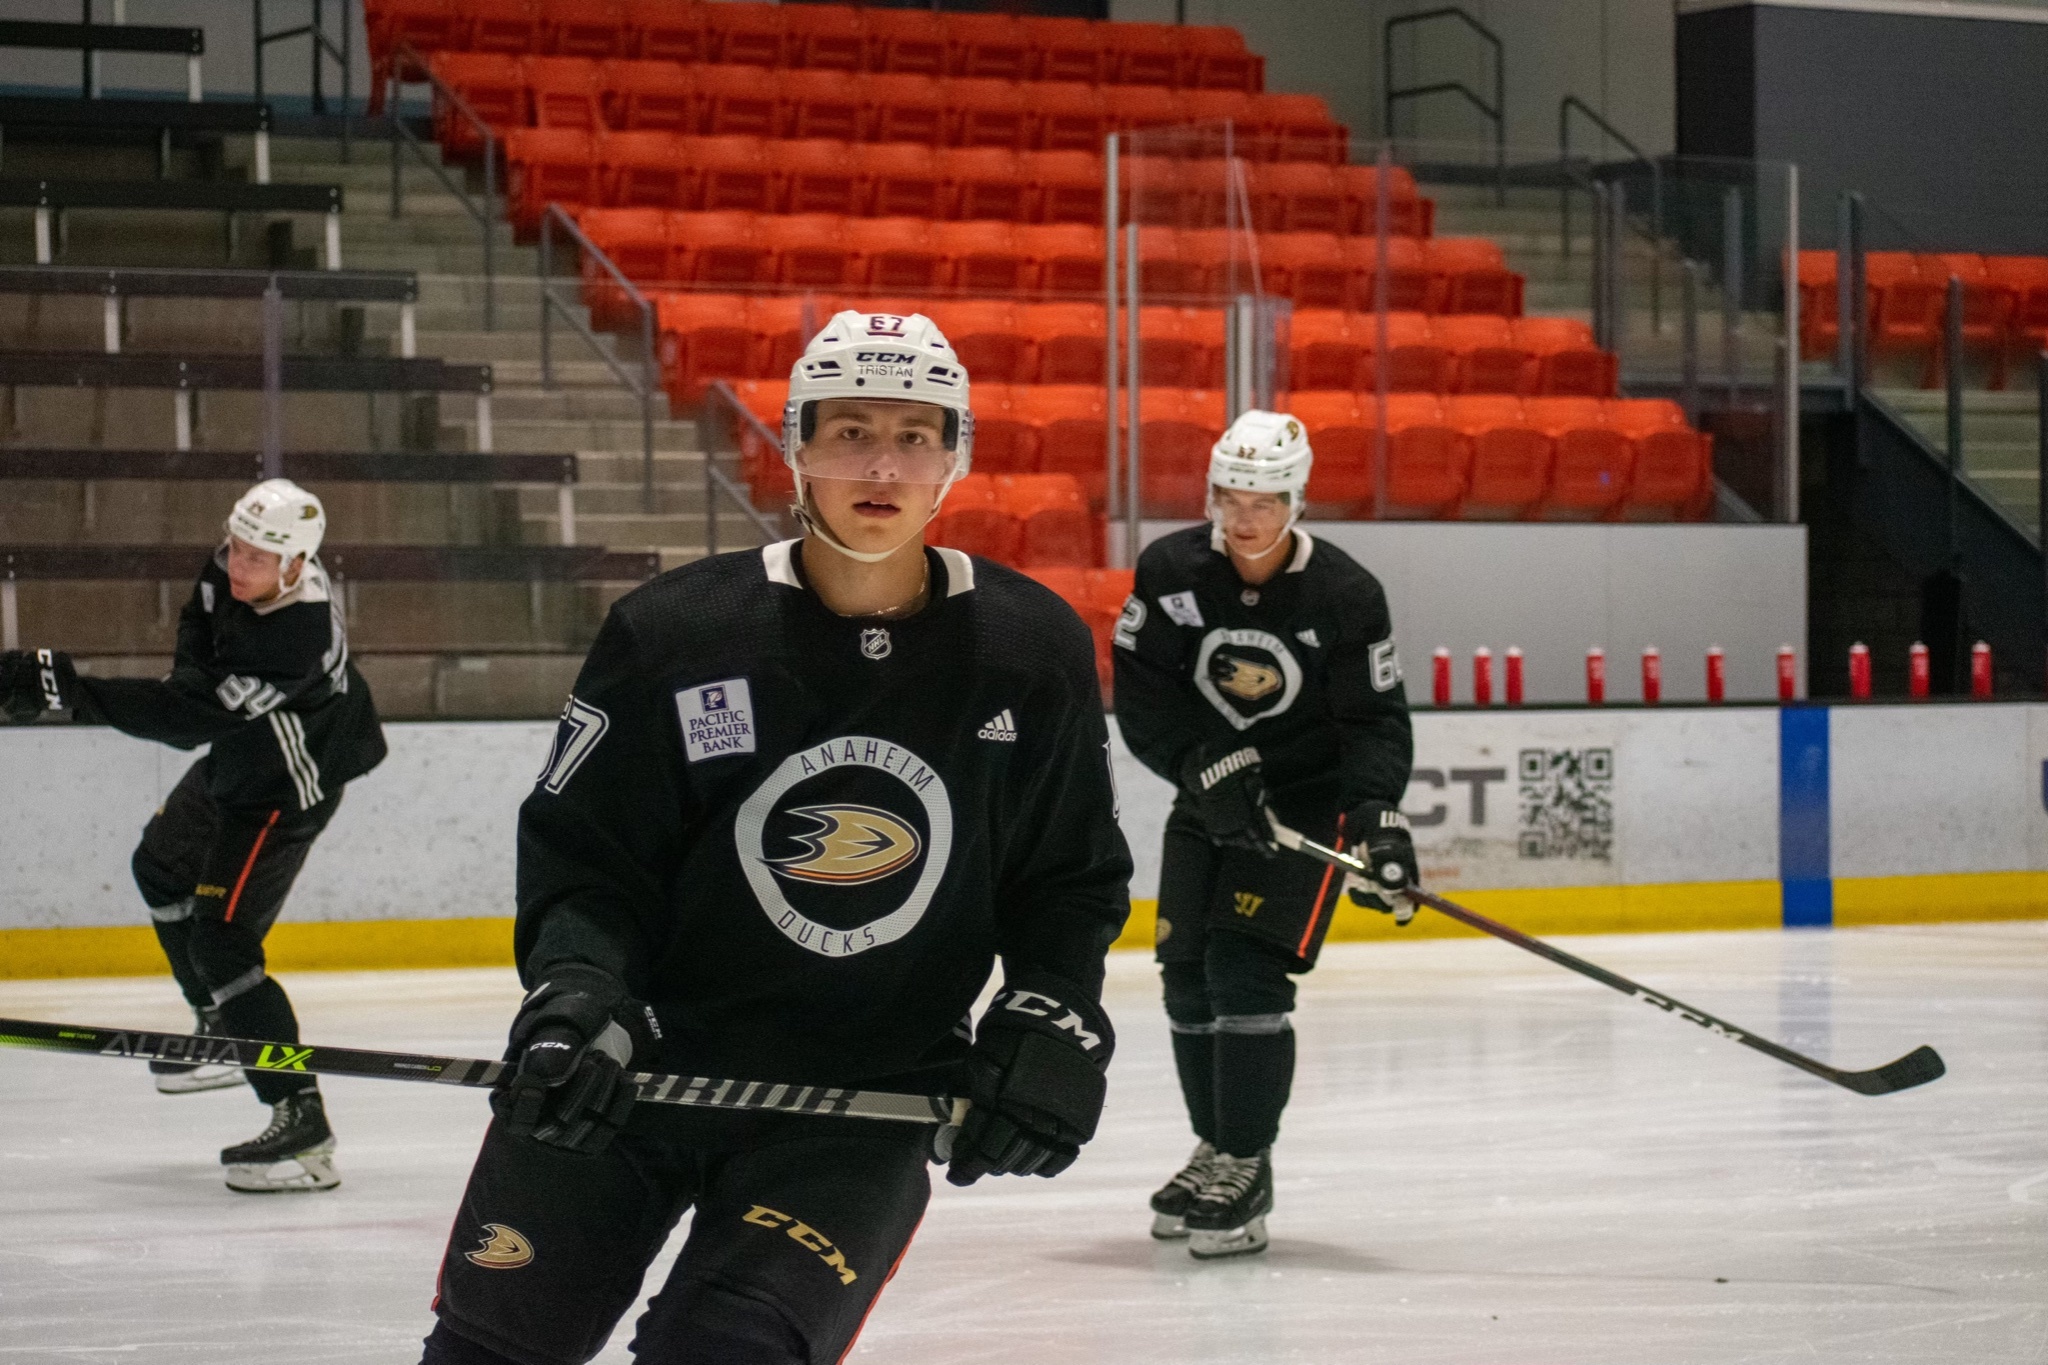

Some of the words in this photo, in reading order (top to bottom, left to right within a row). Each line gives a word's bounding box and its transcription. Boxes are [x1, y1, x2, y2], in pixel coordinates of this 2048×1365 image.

[868, 316, 904, 331] 67
[856, 352, 916, 364] CCM
[858, 364, 913, 378] TRISTAN
[868, 637, 885, 653] NHL
[1367, 638, 1402, 693] 6
[37, 648, 63, 710] CCM
[688, 710, 746, 731] PACIFIC
[537, 694, 609, 795] 7
[688, 723, 752, 745] PREMIER
[977, 728, 1018, 742] adidas
[702, 737, 744, 754] BANK
[799, 739, 936, 793] ANAHEIM
[778, 910, 876, 954] DUCKS
[988, 990, 1101, 1051] CM
[100, 1031, 242, 1066] ALPHA
[255, 1044, 315, 1071] LX
[529, 1041, 571, 1051] CCM
[742, 1204, 858, 1286] CCM
